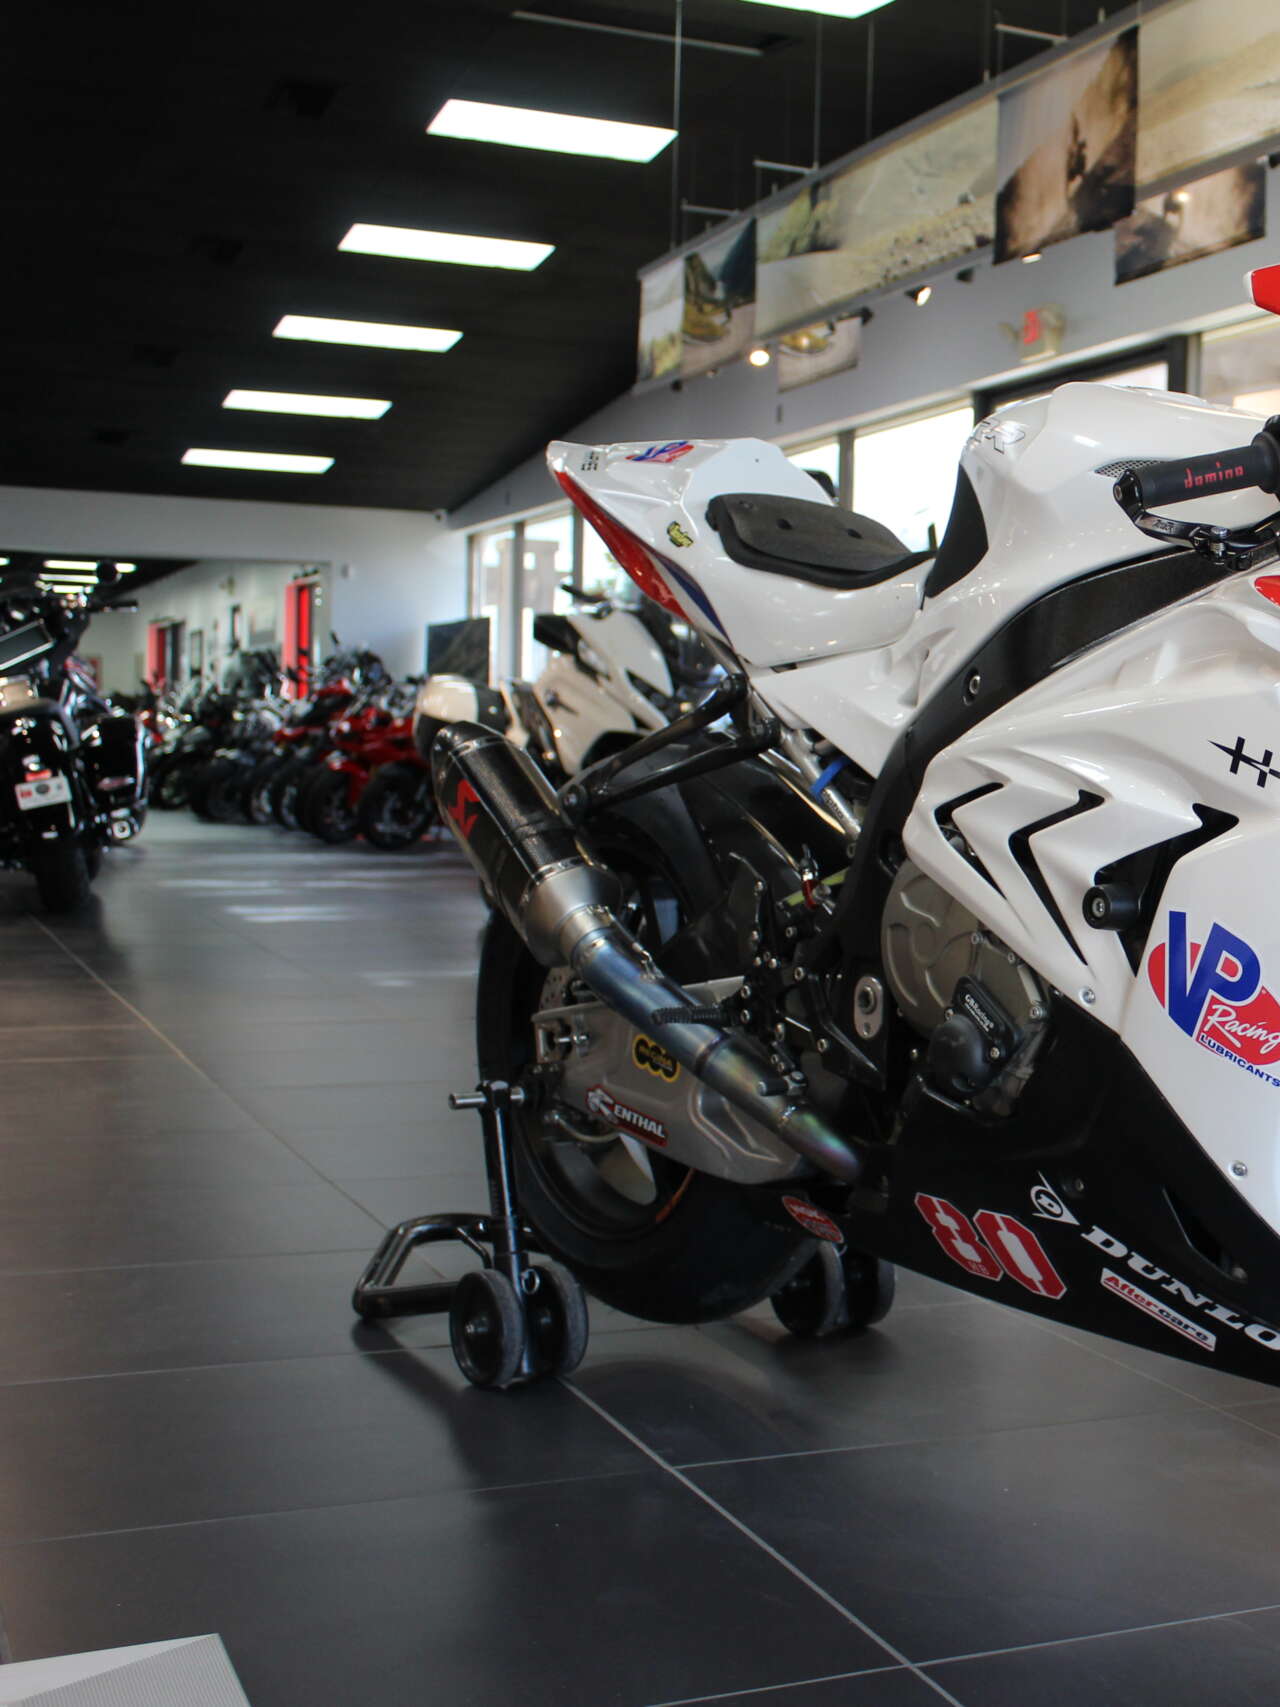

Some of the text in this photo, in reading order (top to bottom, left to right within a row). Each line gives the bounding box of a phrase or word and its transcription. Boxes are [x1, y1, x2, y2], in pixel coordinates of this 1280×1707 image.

[1184, 461, 1245, 489] domino
[1168, 910, 1261, 1038] VP
[914, 1192, 1067, 1300] 80
